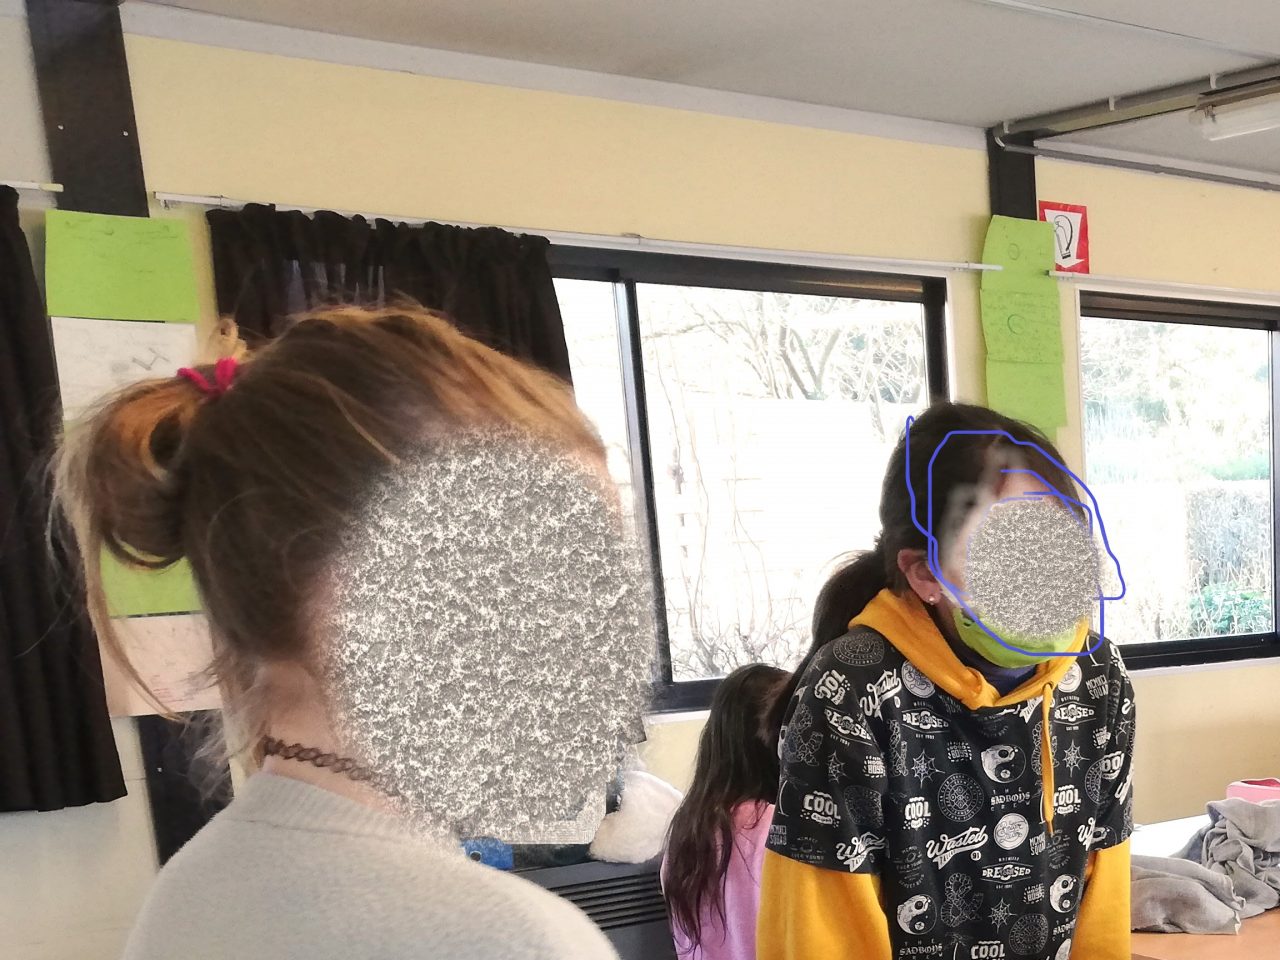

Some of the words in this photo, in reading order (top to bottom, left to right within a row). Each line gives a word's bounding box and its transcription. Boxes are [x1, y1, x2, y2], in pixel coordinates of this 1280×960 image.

[803, 794, 841, 819] COOL
[925, 825, 988, 859] Wasted
[970, 944, 1006, 960] COOL
